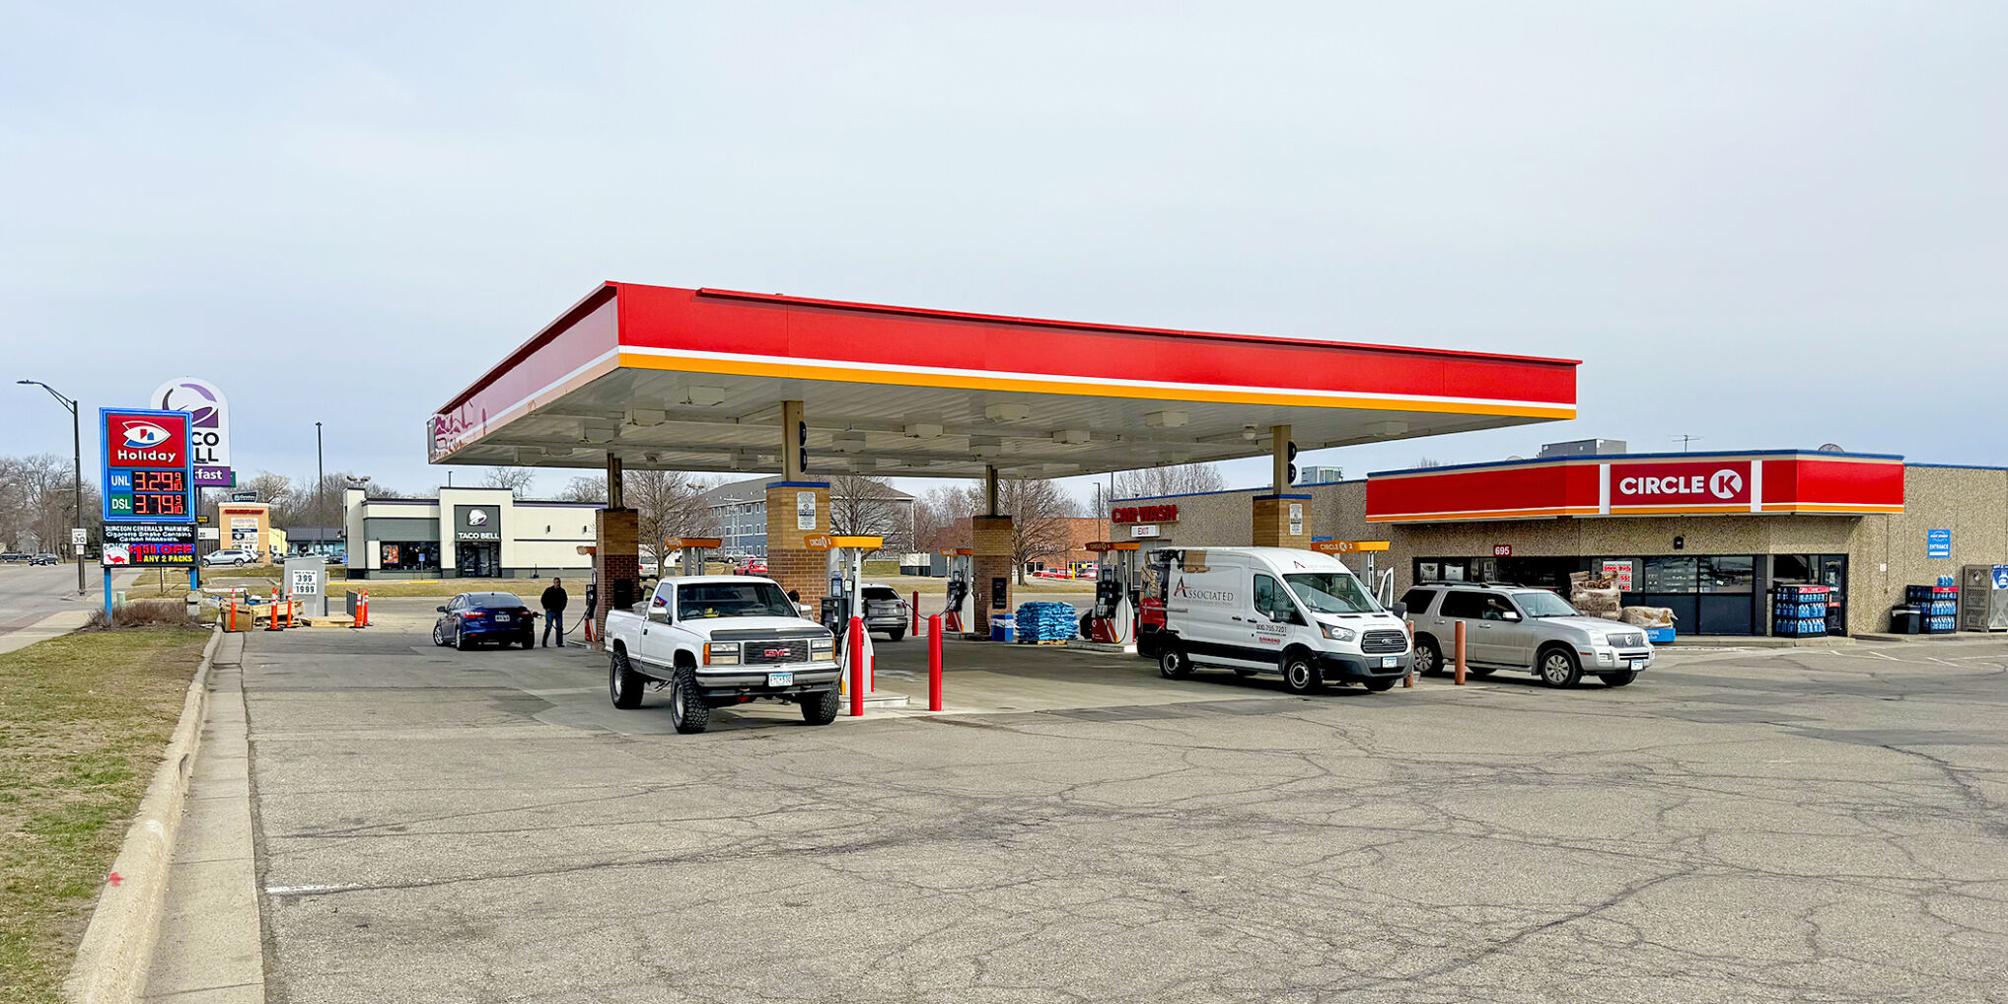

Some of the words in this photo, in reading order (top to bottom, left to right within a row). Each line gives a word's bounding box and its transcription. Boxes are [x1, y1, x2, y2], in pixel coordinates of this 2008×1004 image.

[192, 432, 219, 446] CO
[117, 450, 176, 463] Holiday
[195, 448, 219, 462] LL
[196, 468, 222, 480] fast
[111, 476, 130, 486] UNL
[135, 472, 174, 491] 3.29
[1619, 476, 1704, 495] CIRCLE
[1713, 471, 1742, 499] K
[112, 498, 131, 510] DSL
[135, 495, 174, 514] 3.79
[1112, 507, 1138, 523] CAR
[1139, 505, 1177, 522] WASH
[160, 545, 192, 554] OFF
[1494, 546, 1510, 555] 695
[1174, 576, 1234, 600] ASSOCIATED
[764, 648, 791, 657] GMC
